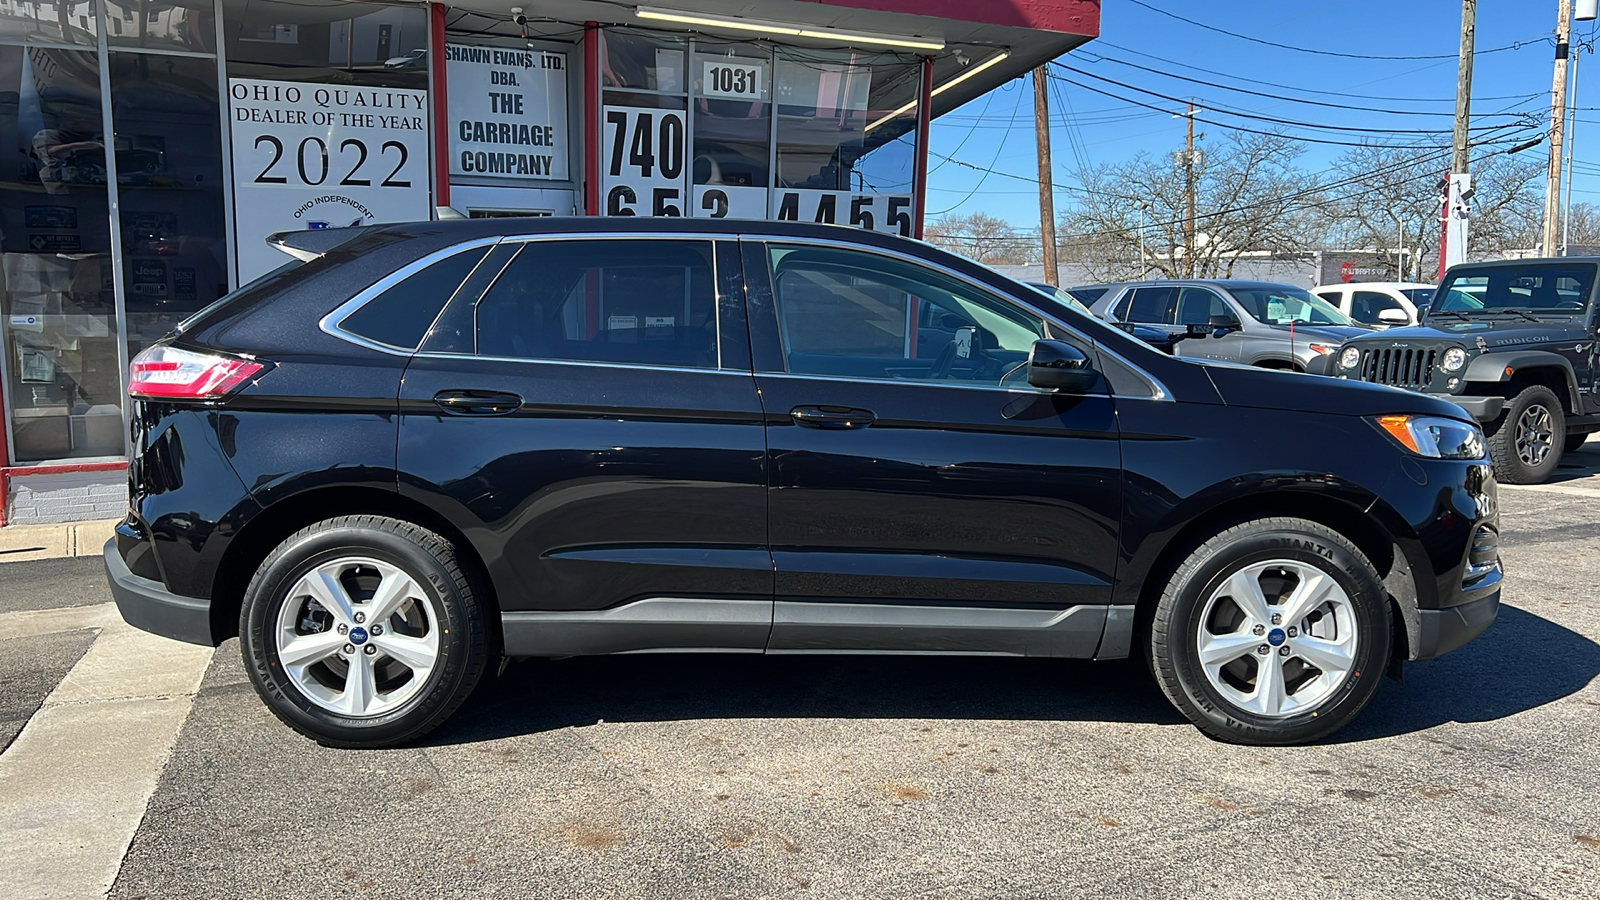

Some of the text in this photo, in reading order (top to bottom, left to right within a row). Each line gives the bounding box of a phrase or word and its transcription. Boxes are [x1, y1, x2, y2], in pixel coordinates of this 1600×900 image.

[445, 43, 490, 64] SHAWN
[541, 55, 564, 70] LTD.
[490, 70, 520, 87] DBA.
[709, 67, 757, 94] 1031
[232, 84, 425, 109] OHIO QUALITY
[488, 92, 524, 115] THE
[235, 107, 423, 130] DEALER OF THE YEAR
[459, 120, 553, 147] CARRIAGE
[606, 110, 683, 180] 740
[254, 134, 411, 188] 2022
[461, 150, 553, 176] COMPANY
[293, 195, 375, 220] OHIO INDEPENDENT
[1495, 335, 1550, 345] RUBICON
